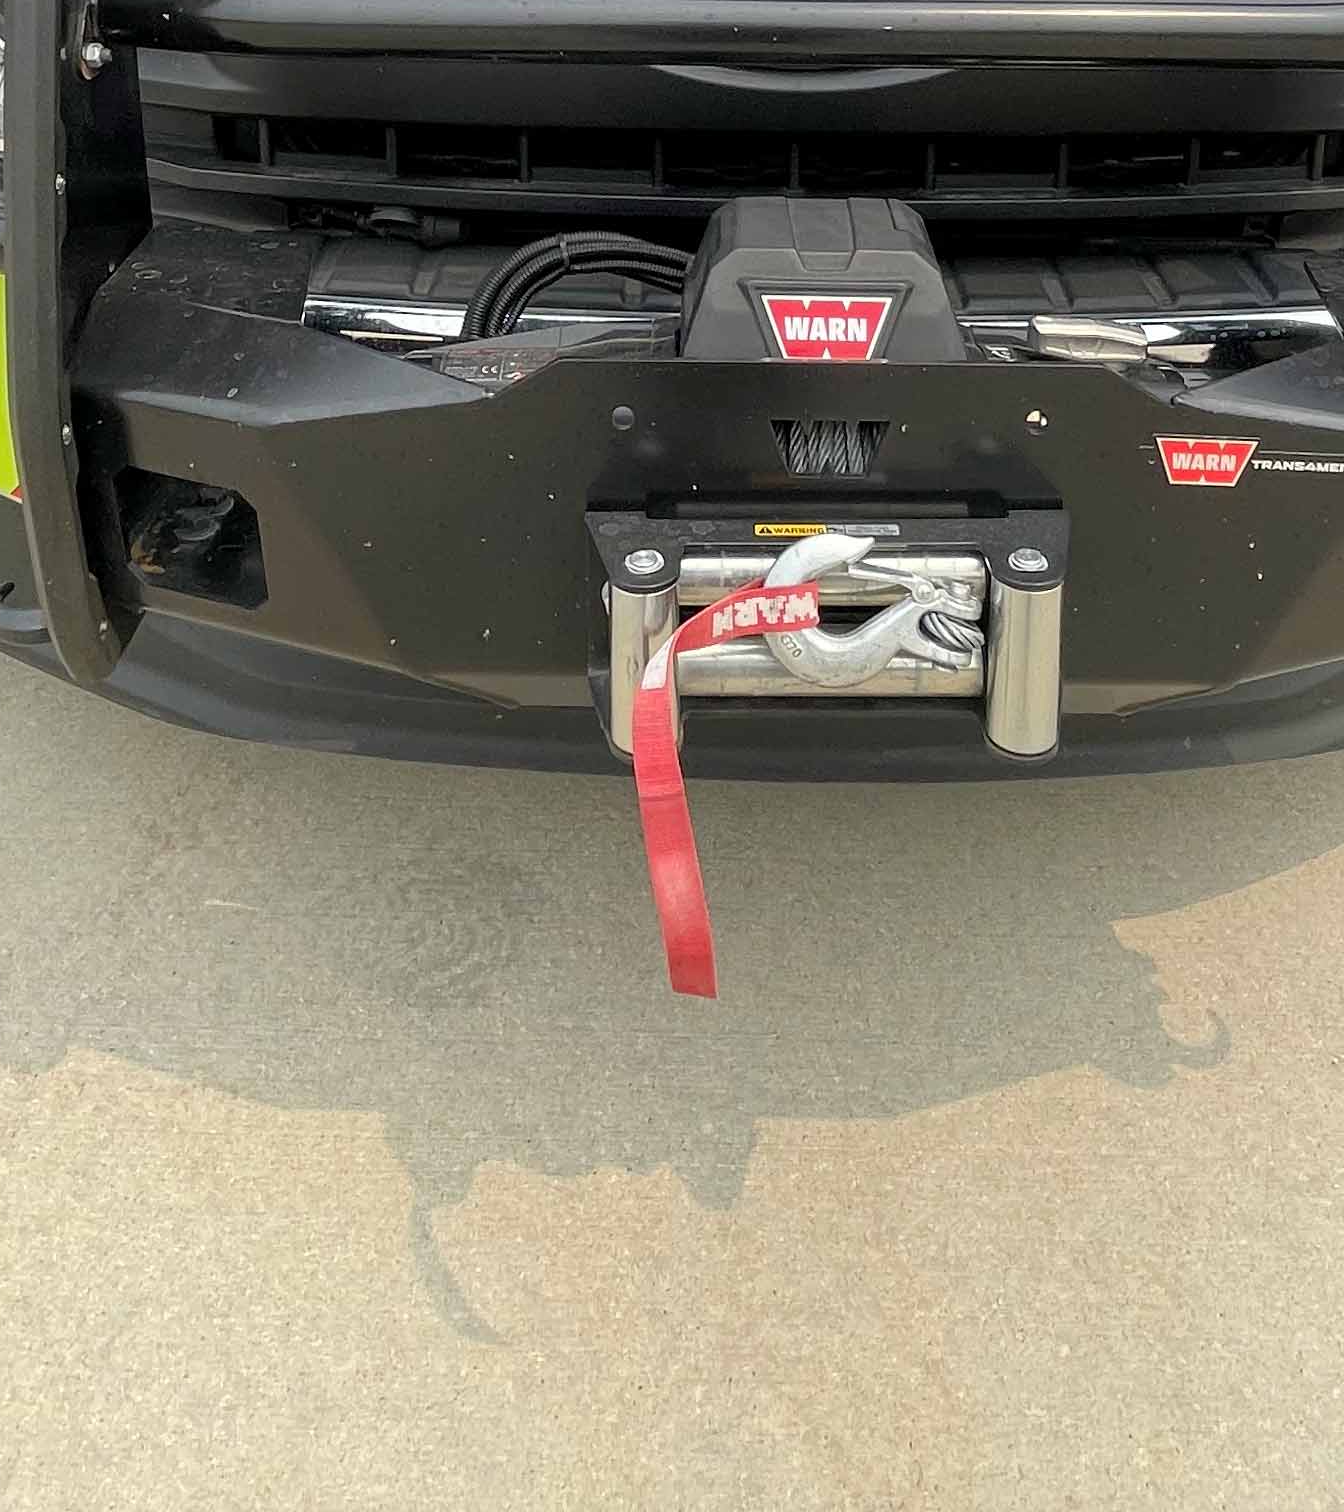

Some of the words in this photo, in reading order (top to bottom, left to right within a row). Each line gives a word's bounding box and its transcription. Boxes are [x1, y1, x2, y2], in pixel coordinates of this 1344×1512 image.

[784, 316, 868, 342] WARN
[1172, 452, 1237, 472] WARN
[773, 527, 825, 535] WARNING
[712, 592, 817, 639] WARN
